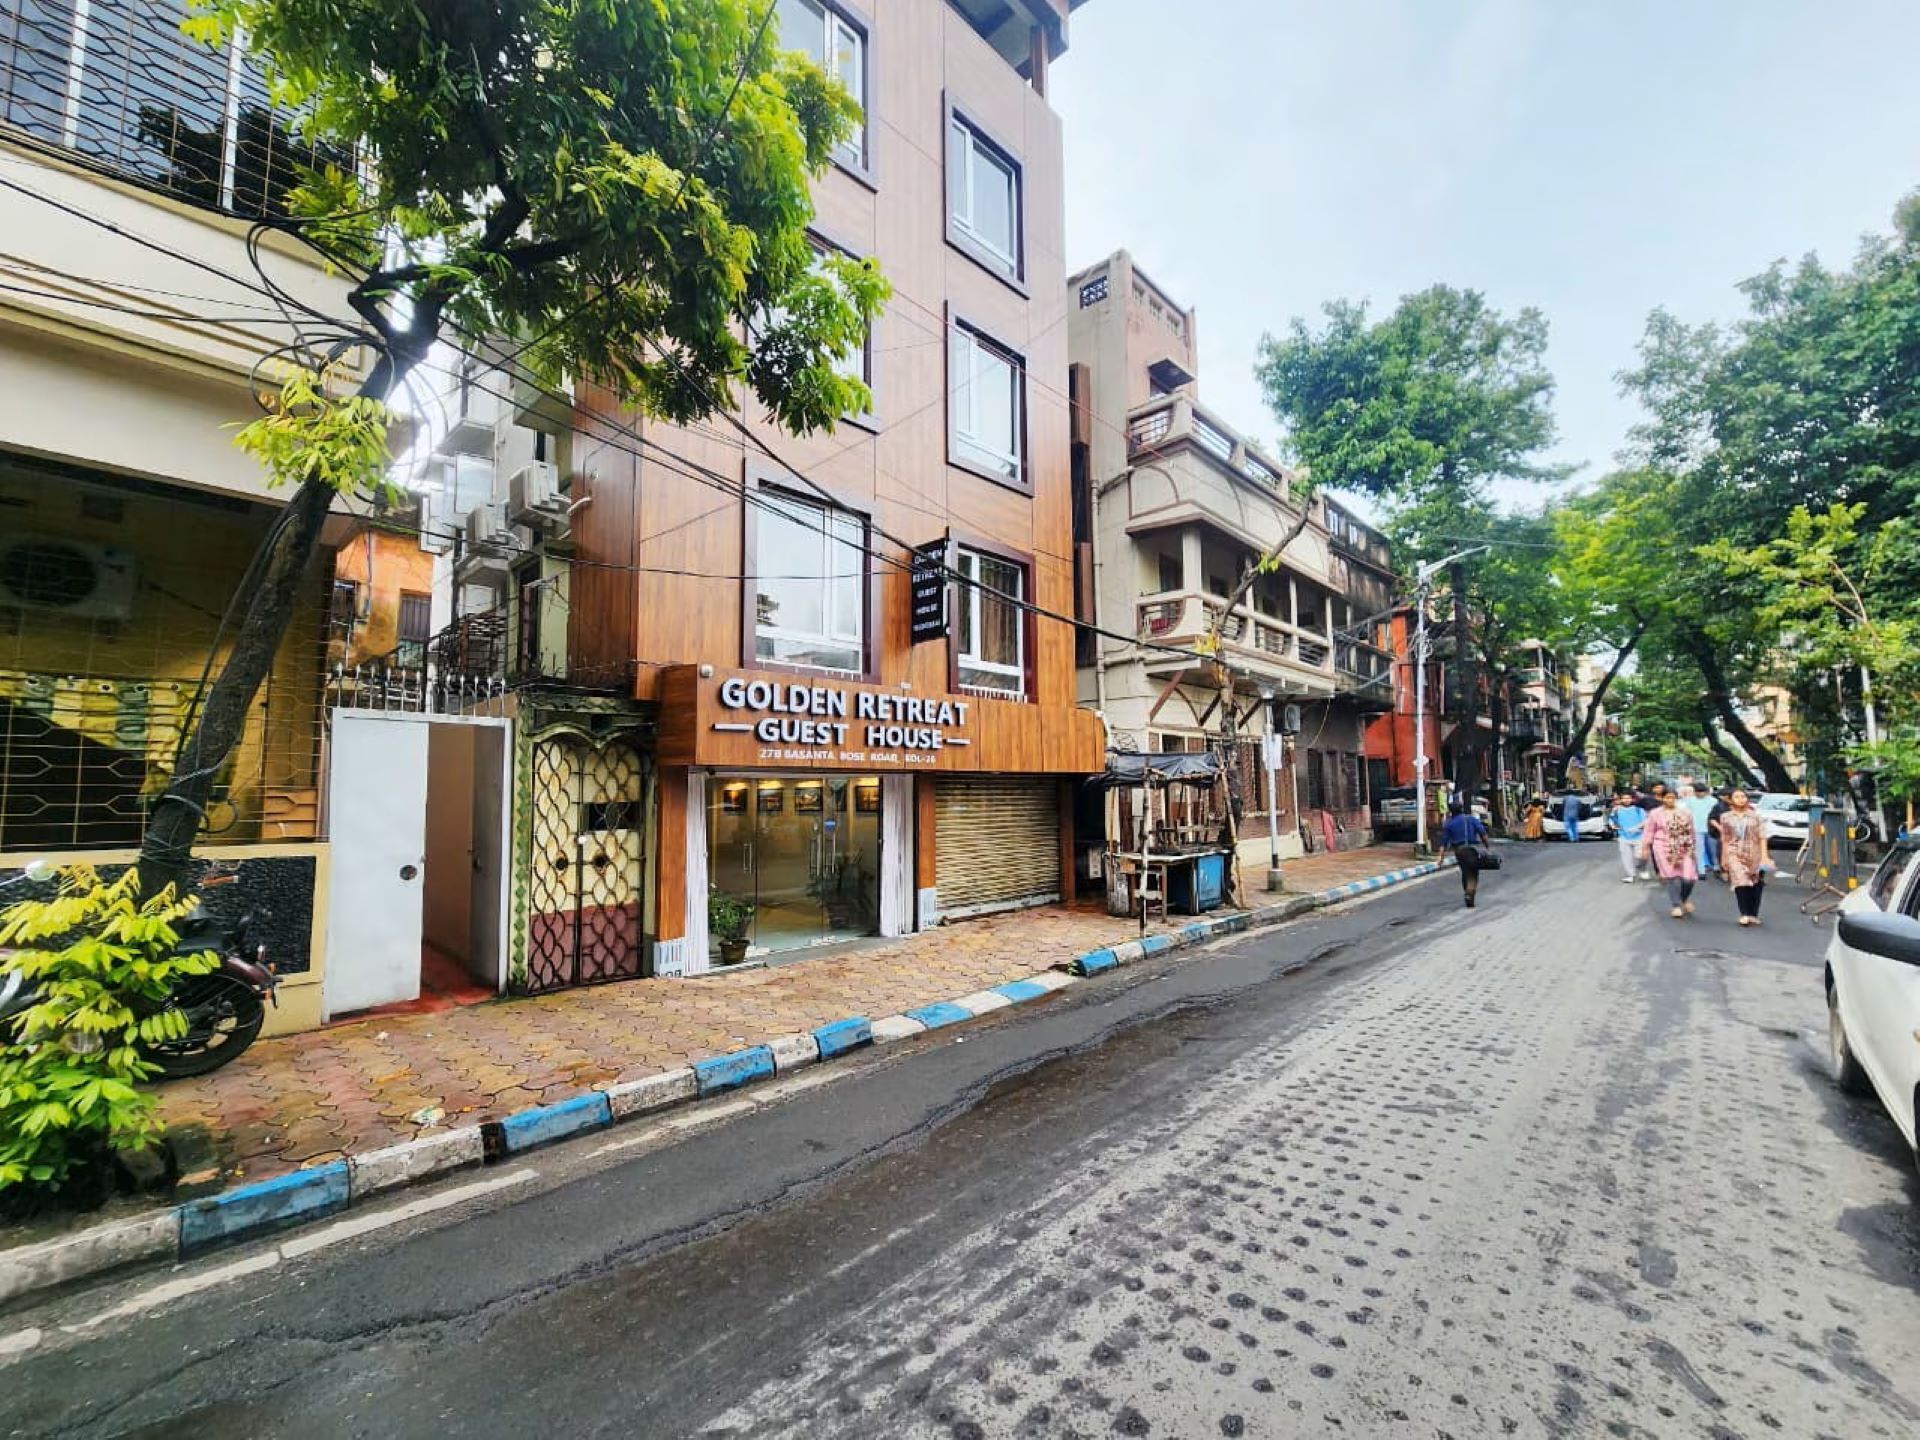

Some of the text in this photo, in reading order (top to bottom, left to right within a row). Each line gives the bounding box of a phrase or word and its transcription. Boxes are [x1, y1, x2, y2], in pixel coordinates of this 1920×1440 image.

[721, 678, 969, 725] GOLDEN RETREAT
[758, 717, 943, 749] GUEST HOUSE
[760, 749, 782, 759] 27B
[783, 749, 835, 760] BASANTA
[839, 751, 865, 761] BOSE
